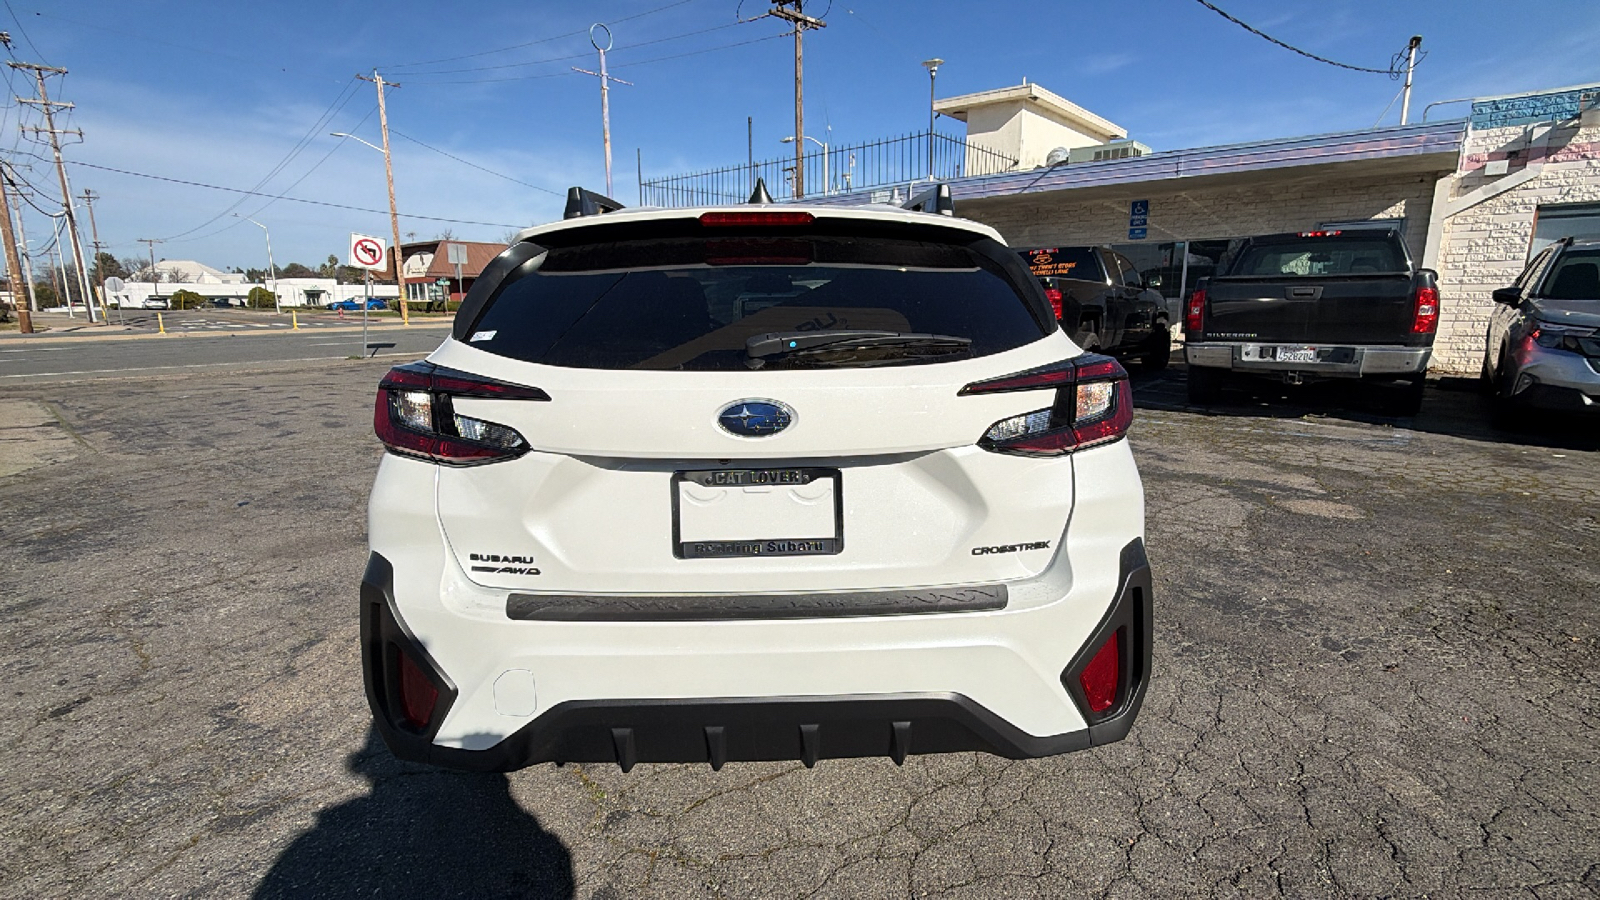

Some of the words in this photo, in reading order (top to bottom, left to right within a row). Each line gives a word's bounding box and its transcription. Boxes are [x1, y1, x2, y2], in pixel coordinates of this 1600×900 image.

[715, 472, 745, 484] CAT
[751, 470, 799, 484] LOVER
[695, 542, 763, 554] Redding
[766, 541, 823, 553] Subaru
[971, 540, 1051, 556] CROSSTREK
[469, 553, 534, 564] SUBARU
[496, 566, 541, 576] AWD
